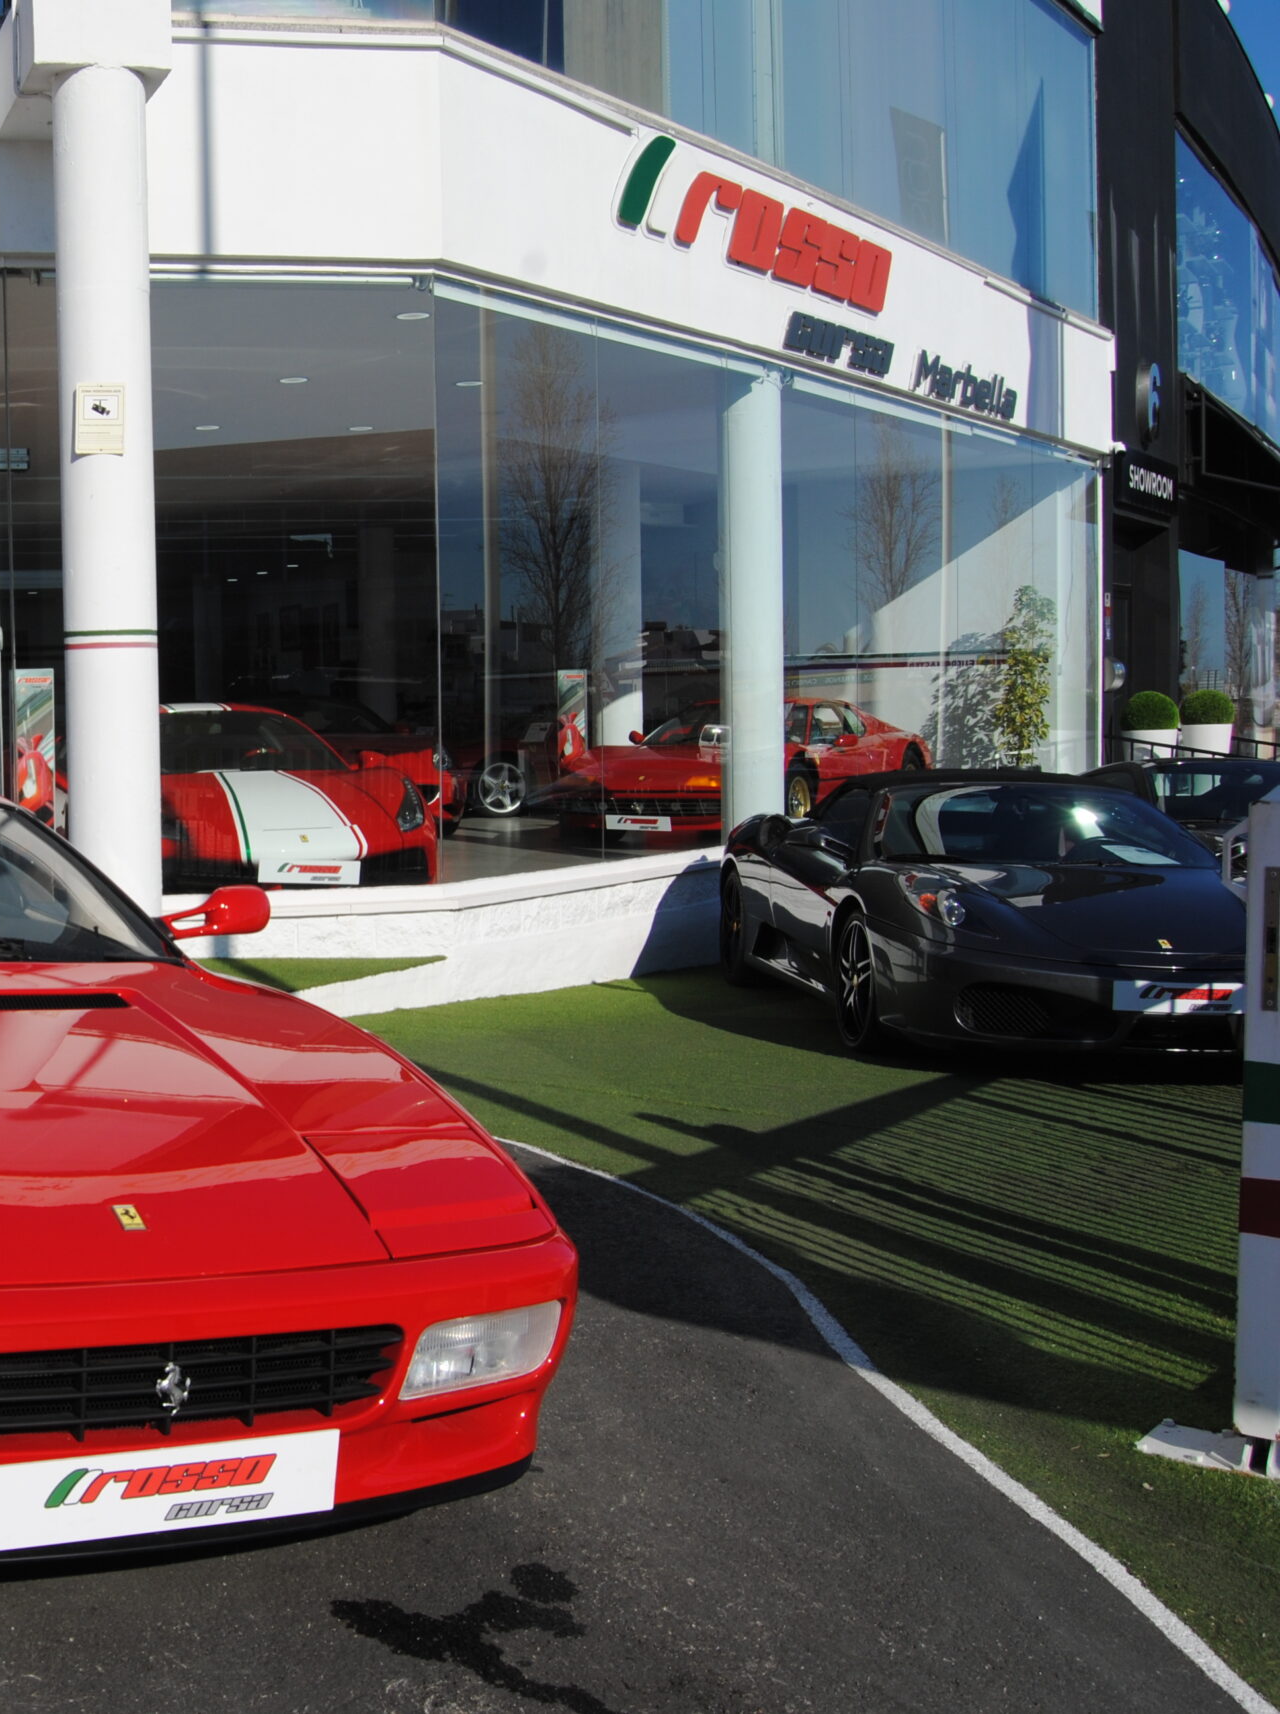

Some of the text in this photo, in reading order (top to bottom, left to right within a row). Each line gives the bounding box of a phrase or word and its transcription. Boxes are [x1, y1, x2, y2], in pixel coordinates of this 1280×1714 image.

[673, 170, 892, 315] rosso
[911, 348, 1018, 421] Marbella
[1128, 463, 1174, 501] SHOWROOM
[79, 1453, 277, 1504] rosso
[164, 1492, 274, 1521] corsa
